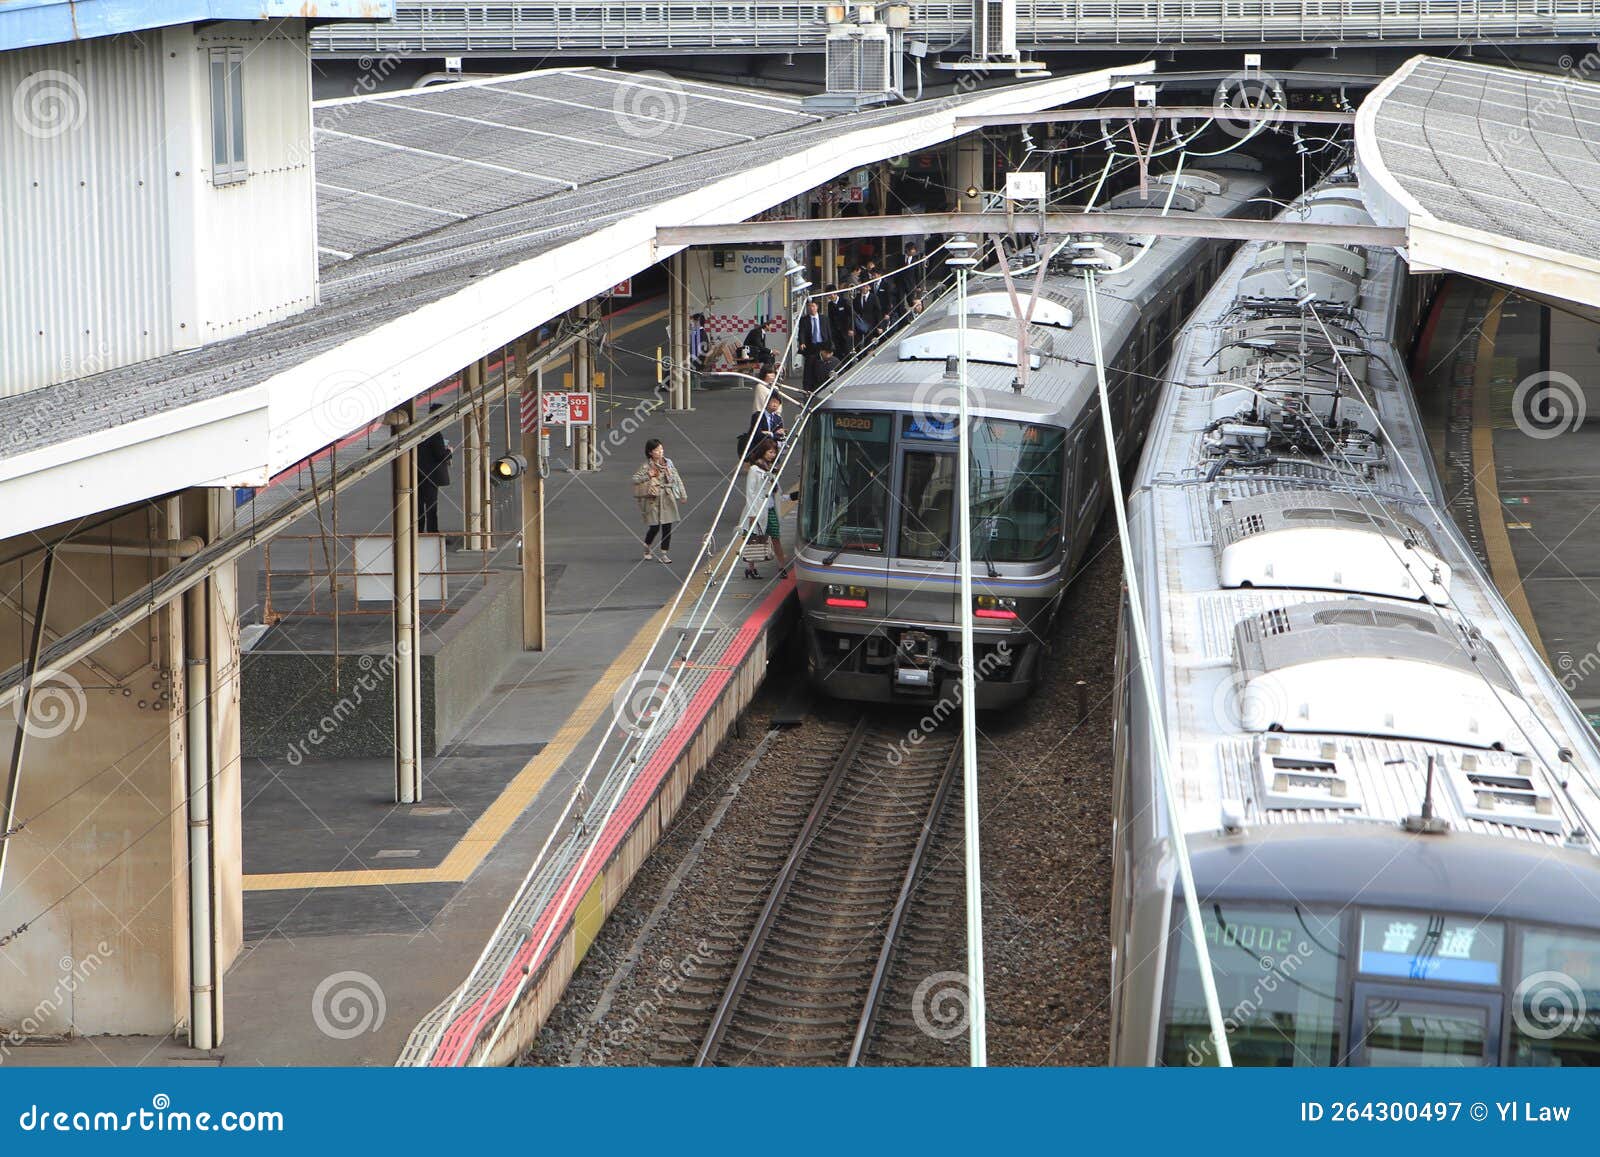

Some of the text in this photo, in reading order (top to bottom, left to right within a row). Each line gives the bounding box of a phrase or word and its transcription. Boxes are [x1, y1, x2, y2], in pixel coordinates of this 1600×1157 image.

[984, 194, 1003, 209] 12
[742, 254, 782, 266] Vending
[744, 265, 780, 274] Corner
[569, 398, 587, 406] SOS
[1382, 921, 1476, 959] 普通
